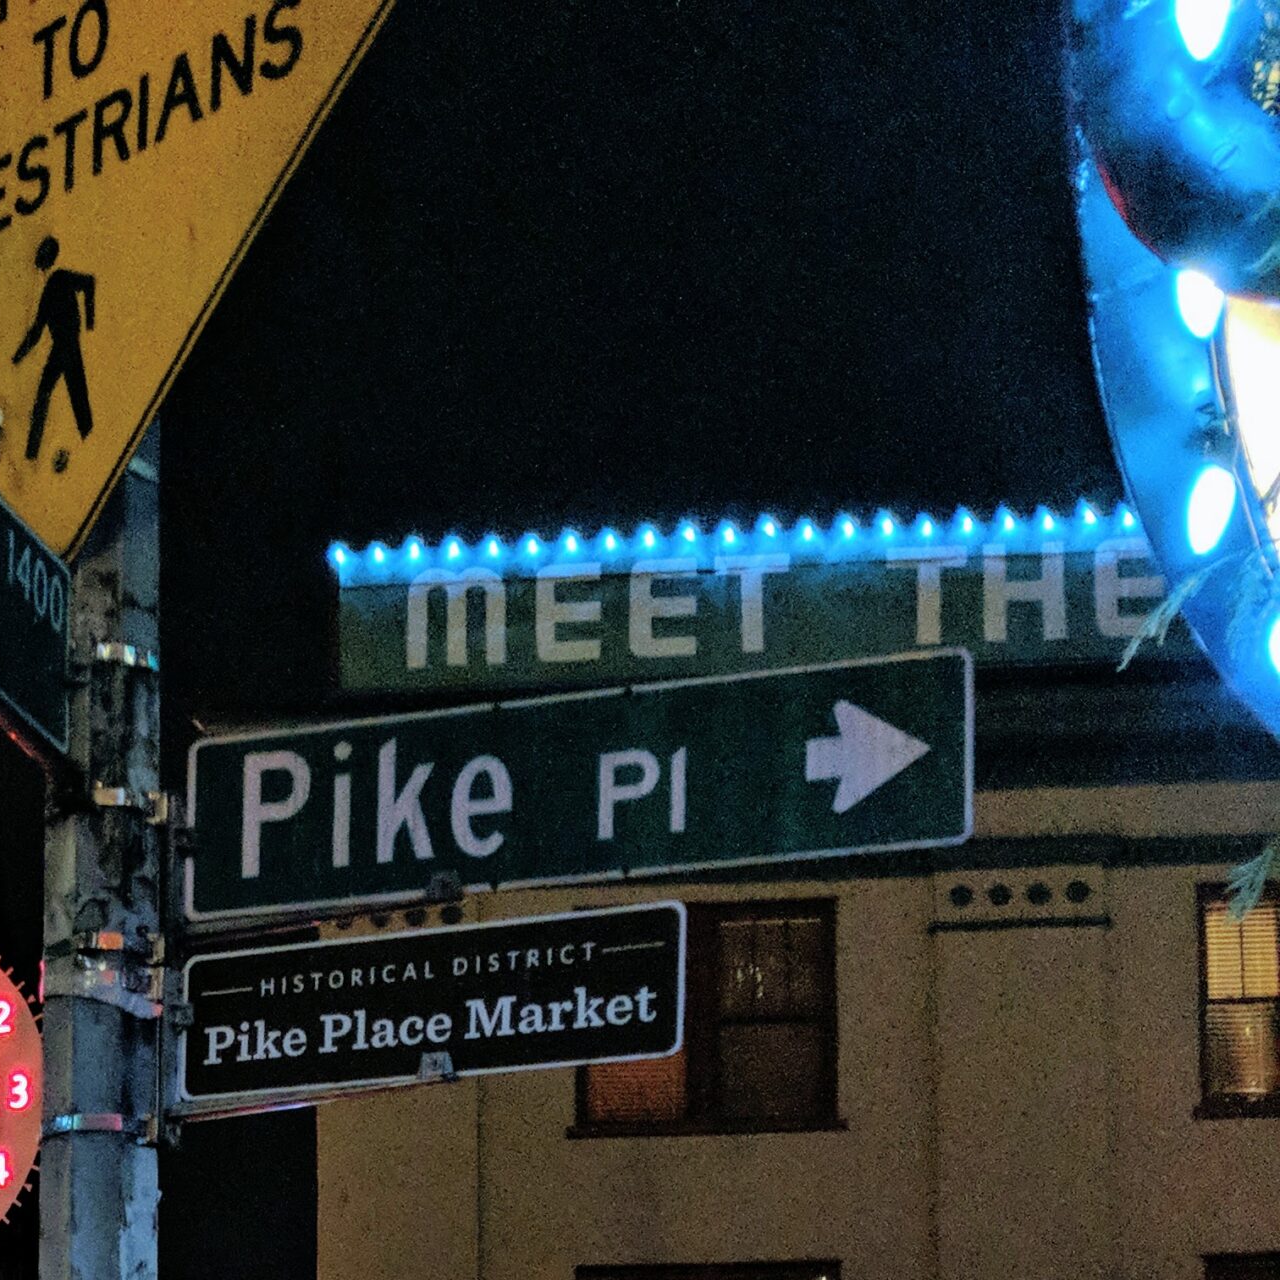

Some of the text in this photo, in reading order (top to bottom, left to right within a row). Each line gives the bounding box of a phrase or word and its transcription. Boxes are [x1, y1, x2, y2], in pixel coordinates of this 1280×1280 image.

[34, 0, 109, 99] TO
[6, 530, 65, 631] 1400
[406, 537, 1167, 670] MEET THE
[240, 738, 687, 880] Pike Pl
[260, 941, 598, 997] HISTORICAL DISTRICT
[203, 984, 658, 1067] Pike Place Market
[9, 1074, 29, 1109] 3
